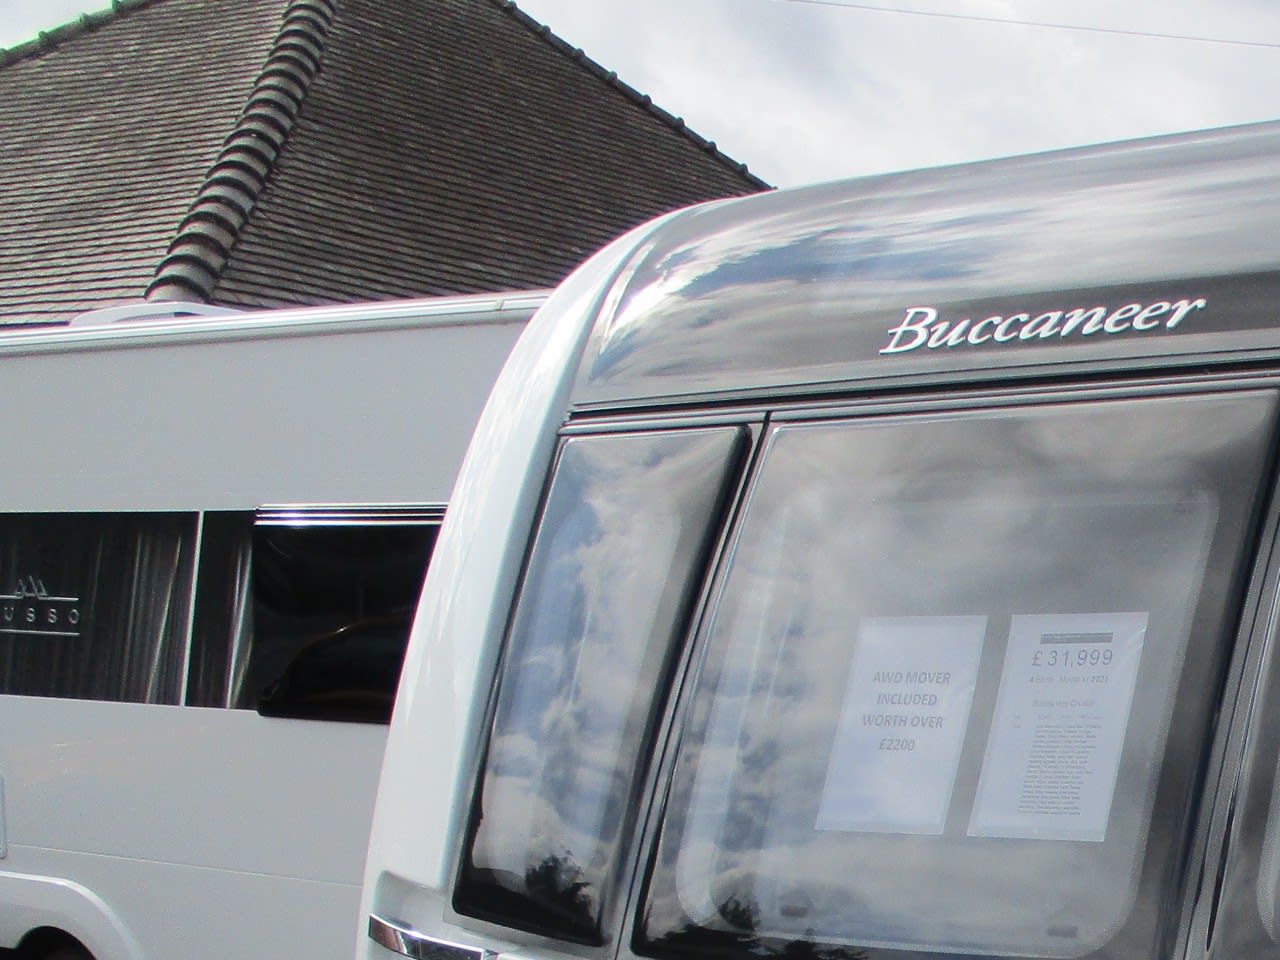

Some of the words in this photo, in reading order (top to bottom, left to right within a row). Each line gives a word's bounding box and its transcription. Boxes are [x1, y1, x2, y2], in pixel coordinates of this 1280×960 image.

[879, 298, 1207, 354] Buccaneer
[873, 671, 902, 683] AWD
[906, 672, 951, 685] MOVER
[877, 693, 937, 706] INCLUDED
[863, 714, 908, 727] WORTH
[911, 715, 944, 728] OVER
